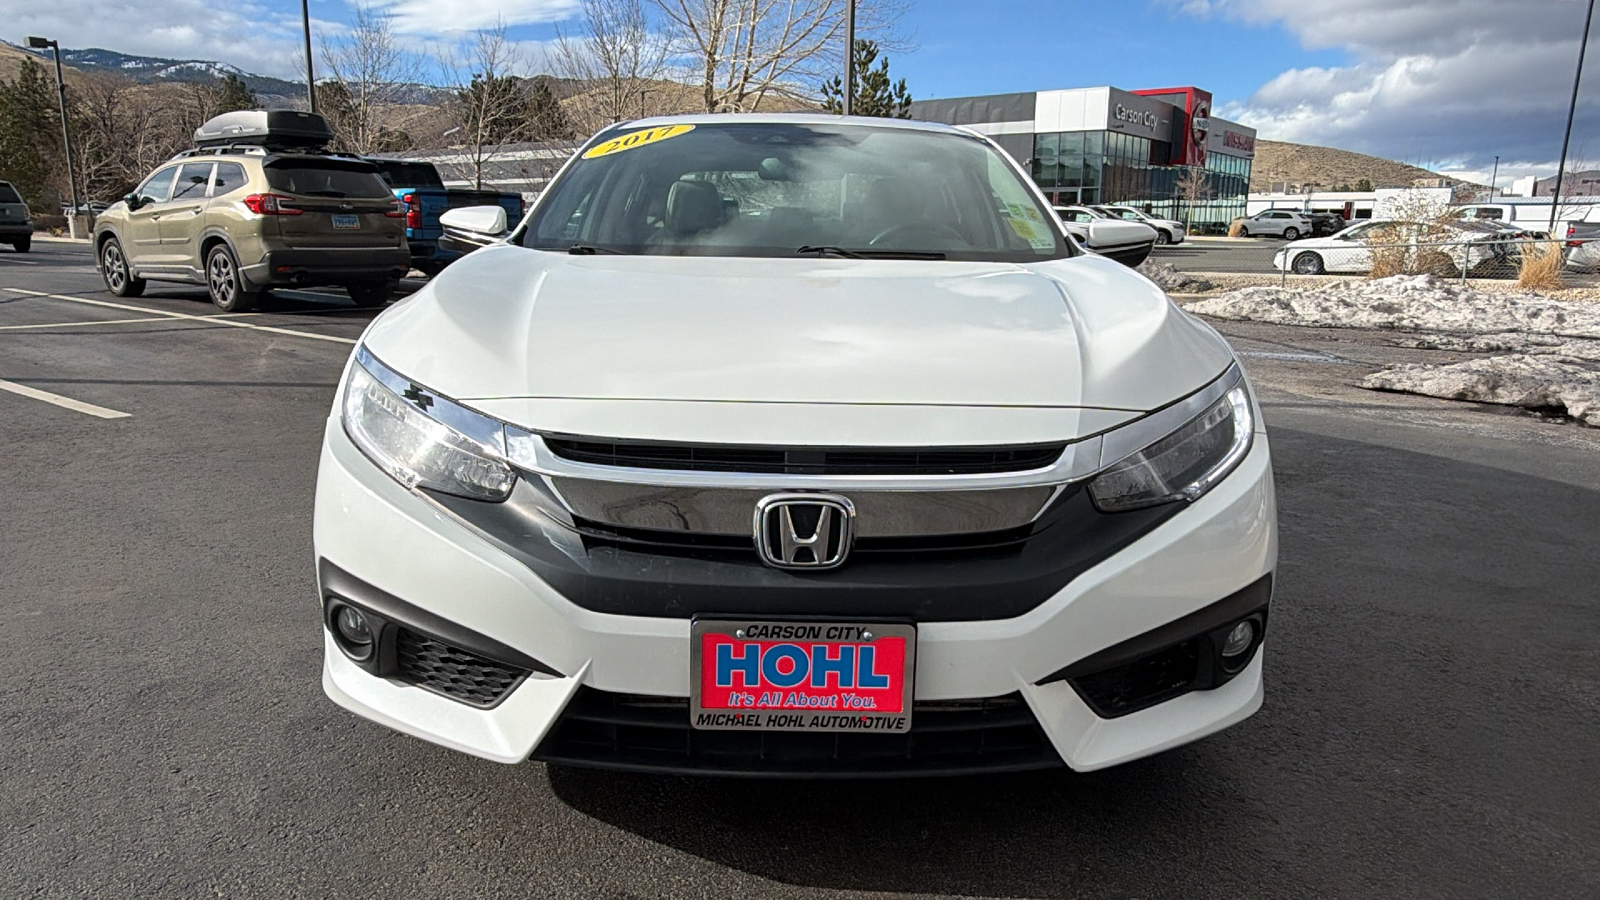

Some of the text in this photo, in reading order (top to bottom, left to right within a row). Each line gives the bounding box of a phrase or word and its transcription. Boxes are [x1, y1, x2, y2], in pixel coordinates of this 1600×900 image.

[1116, 103, 1159, 132] Carson City
[605, 126, 676, 153] 2017
[746, 625, 865, 641] CARSON CITY
[715, 643, 890, 689] HOHL
[728, 691, 876, 708] It's All About You.
[696, 713, 906, 730] MICHAEL HOHL AUTOMOTIVE
